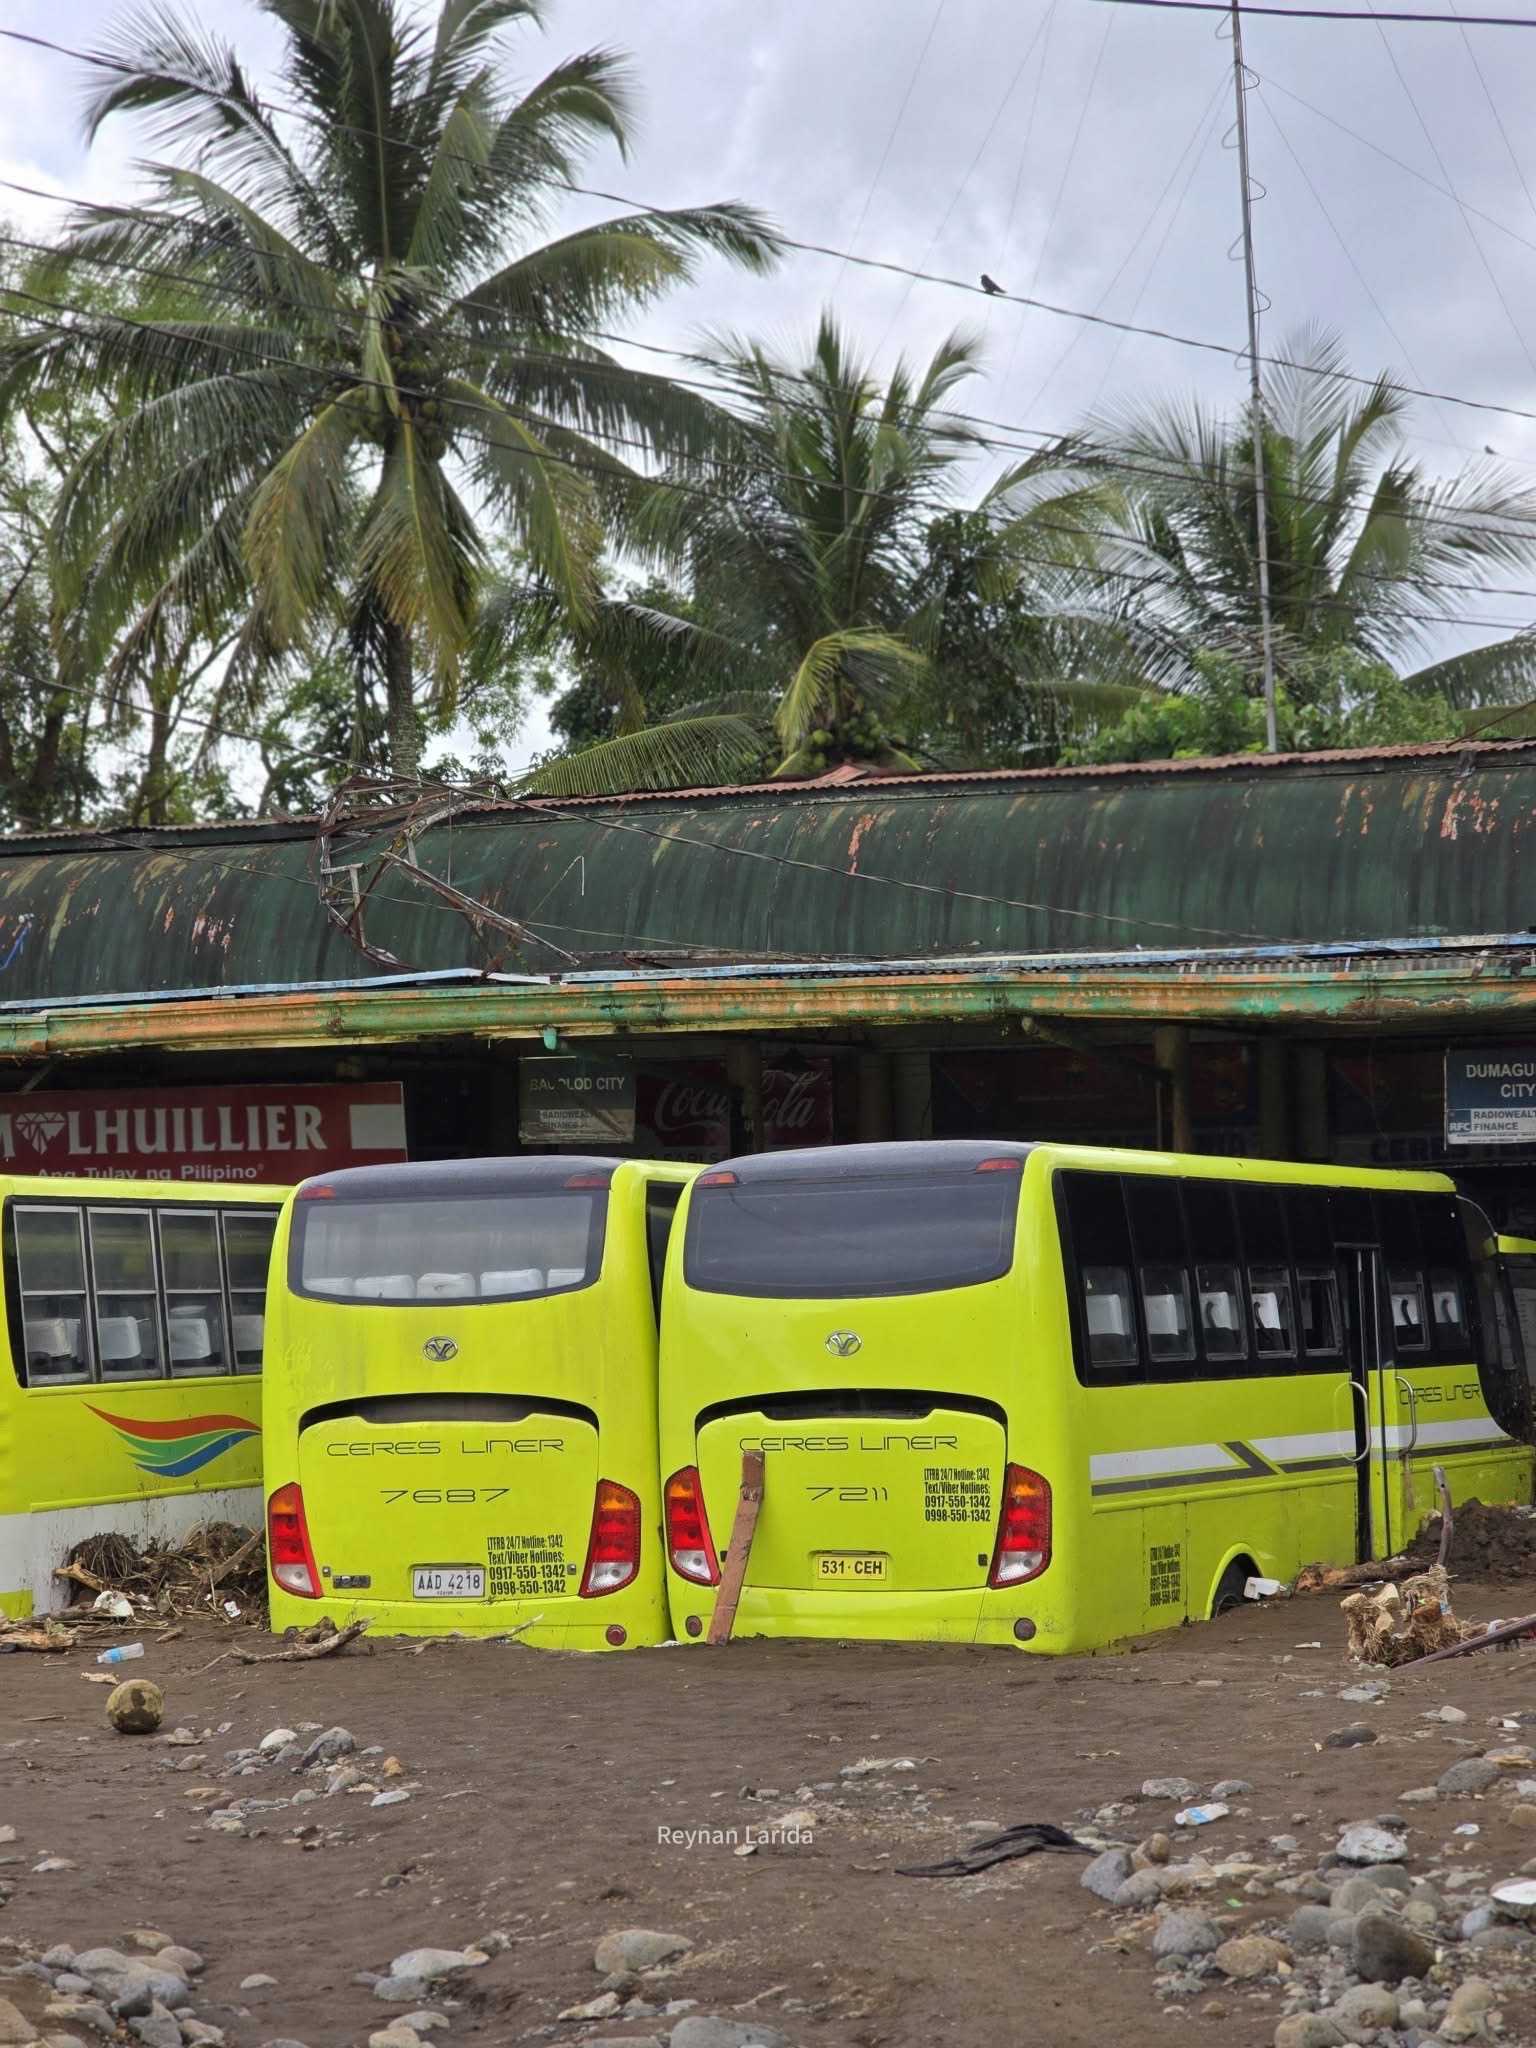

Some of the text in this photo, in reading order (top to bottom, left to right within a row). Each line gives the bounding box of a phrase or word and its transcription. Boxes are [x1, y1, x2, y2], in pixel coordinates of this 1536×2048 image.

[1465, 1062, 1536, 1078] DUMAGU
[596, 1076, 625, 1090] CITY
[1500, 1083, 1536, 1098] CITY
[67, 1104, 328, 1155] LHUILLIER
[1448, 1122, 1471, 1131] RFC
[1473, 1121, 1519, 1131] FINANCE
[326, 1438, 565, 1457] CERES LINER
[739, 1435, 958, 1451] CERES LINER
[976, 1467, 990, 1480] 1342
[380, 1488, 511, 1505] 7687
[806, 1486, 888, 1502] 7211
[925, 1495, 991, 1508] 0917-550-1342
[925, 1508, 991, 1522] 0998-550-1342
[487, 1536, 505, 1551] LTFRB
[506, 1535, 521, 1550] 24/7
[547, 1533, 563, 1548] 1342
[487, 1550, 528, 1566] Text/Viber
[489, 1563, 566, 1580] 0917-550-1342
[821, 1560, 882, 1574] 531 CEH
[417, 1573, 481, 1591] AAD 4218
[490, 1579, 567, 1596] 0998-550-1342
